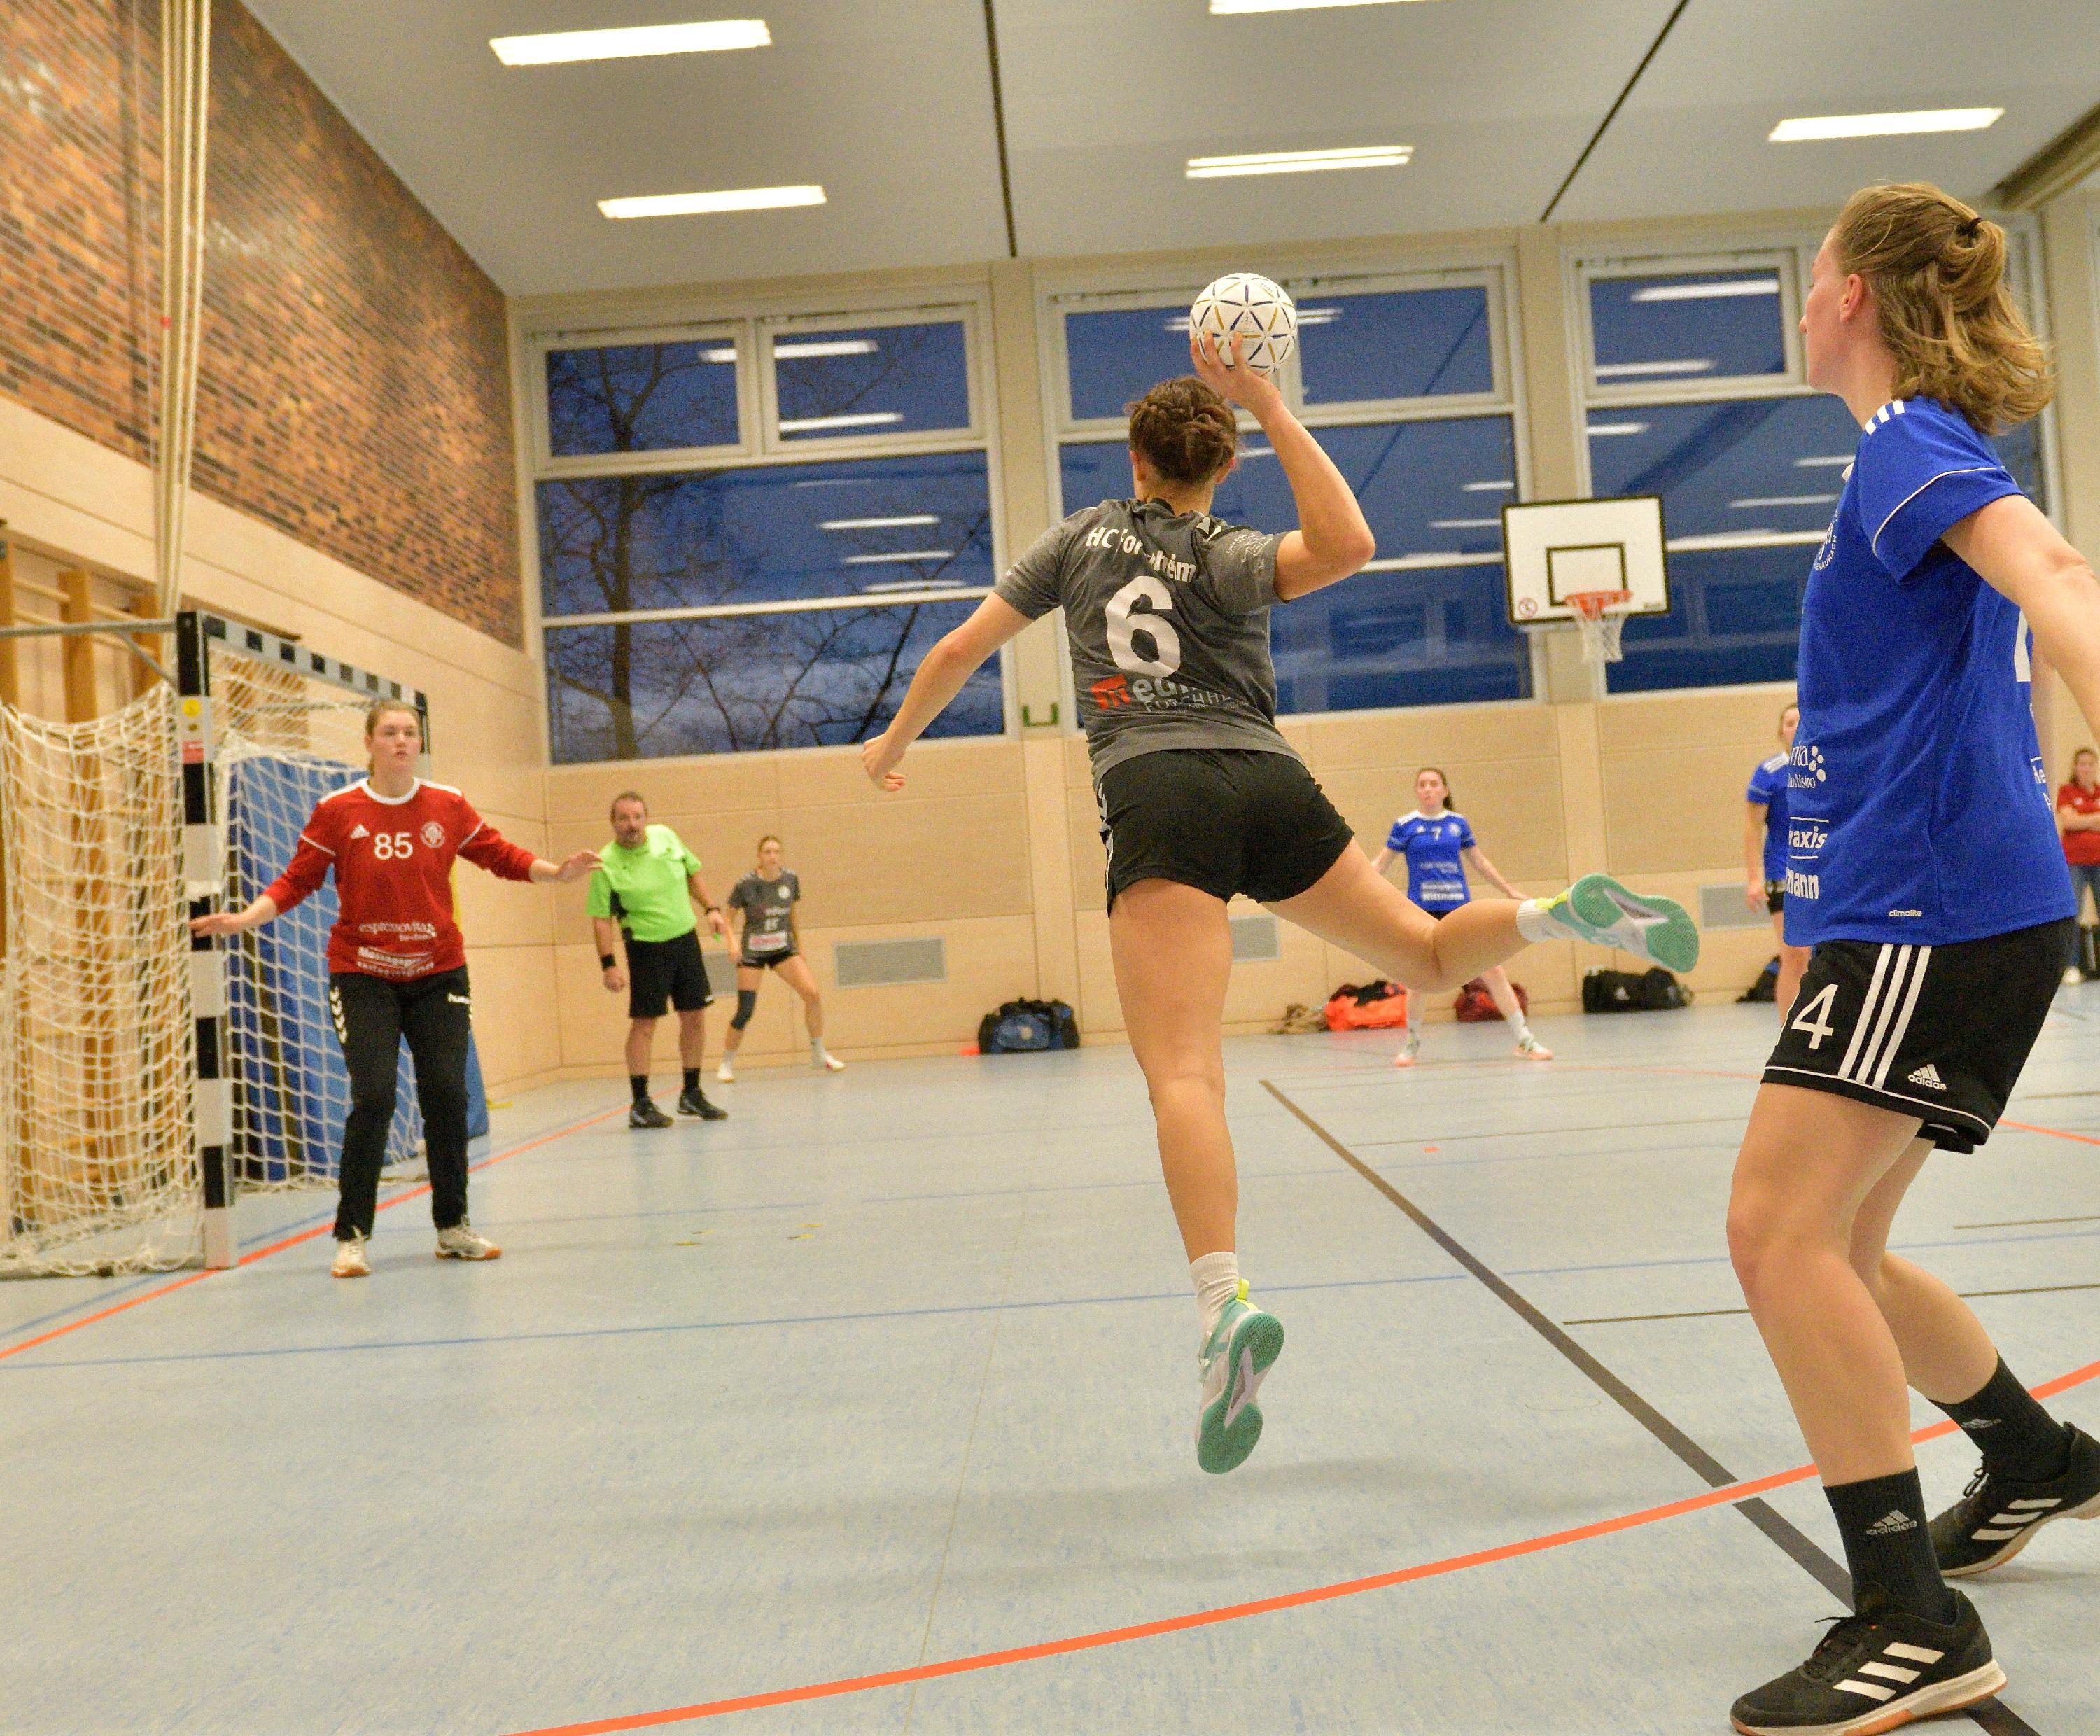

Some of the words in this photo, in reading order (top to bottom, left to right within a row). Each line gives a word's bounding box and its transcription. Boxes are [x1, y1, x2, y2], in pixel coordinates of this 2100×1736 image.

[1086, 526, 1119, 549] HC
[1105, 576, 1181, 678] 6
[1432, 827, 1442, 841] 7
[373, 832, 414, 860] 85
[1888, 909, 1923, 918] climalite
[1791, 983, 1839, 1049] 4
[1907, 1074, 1947, 1091] adidas
[1866, 1520, 1918, 1536] adidas
